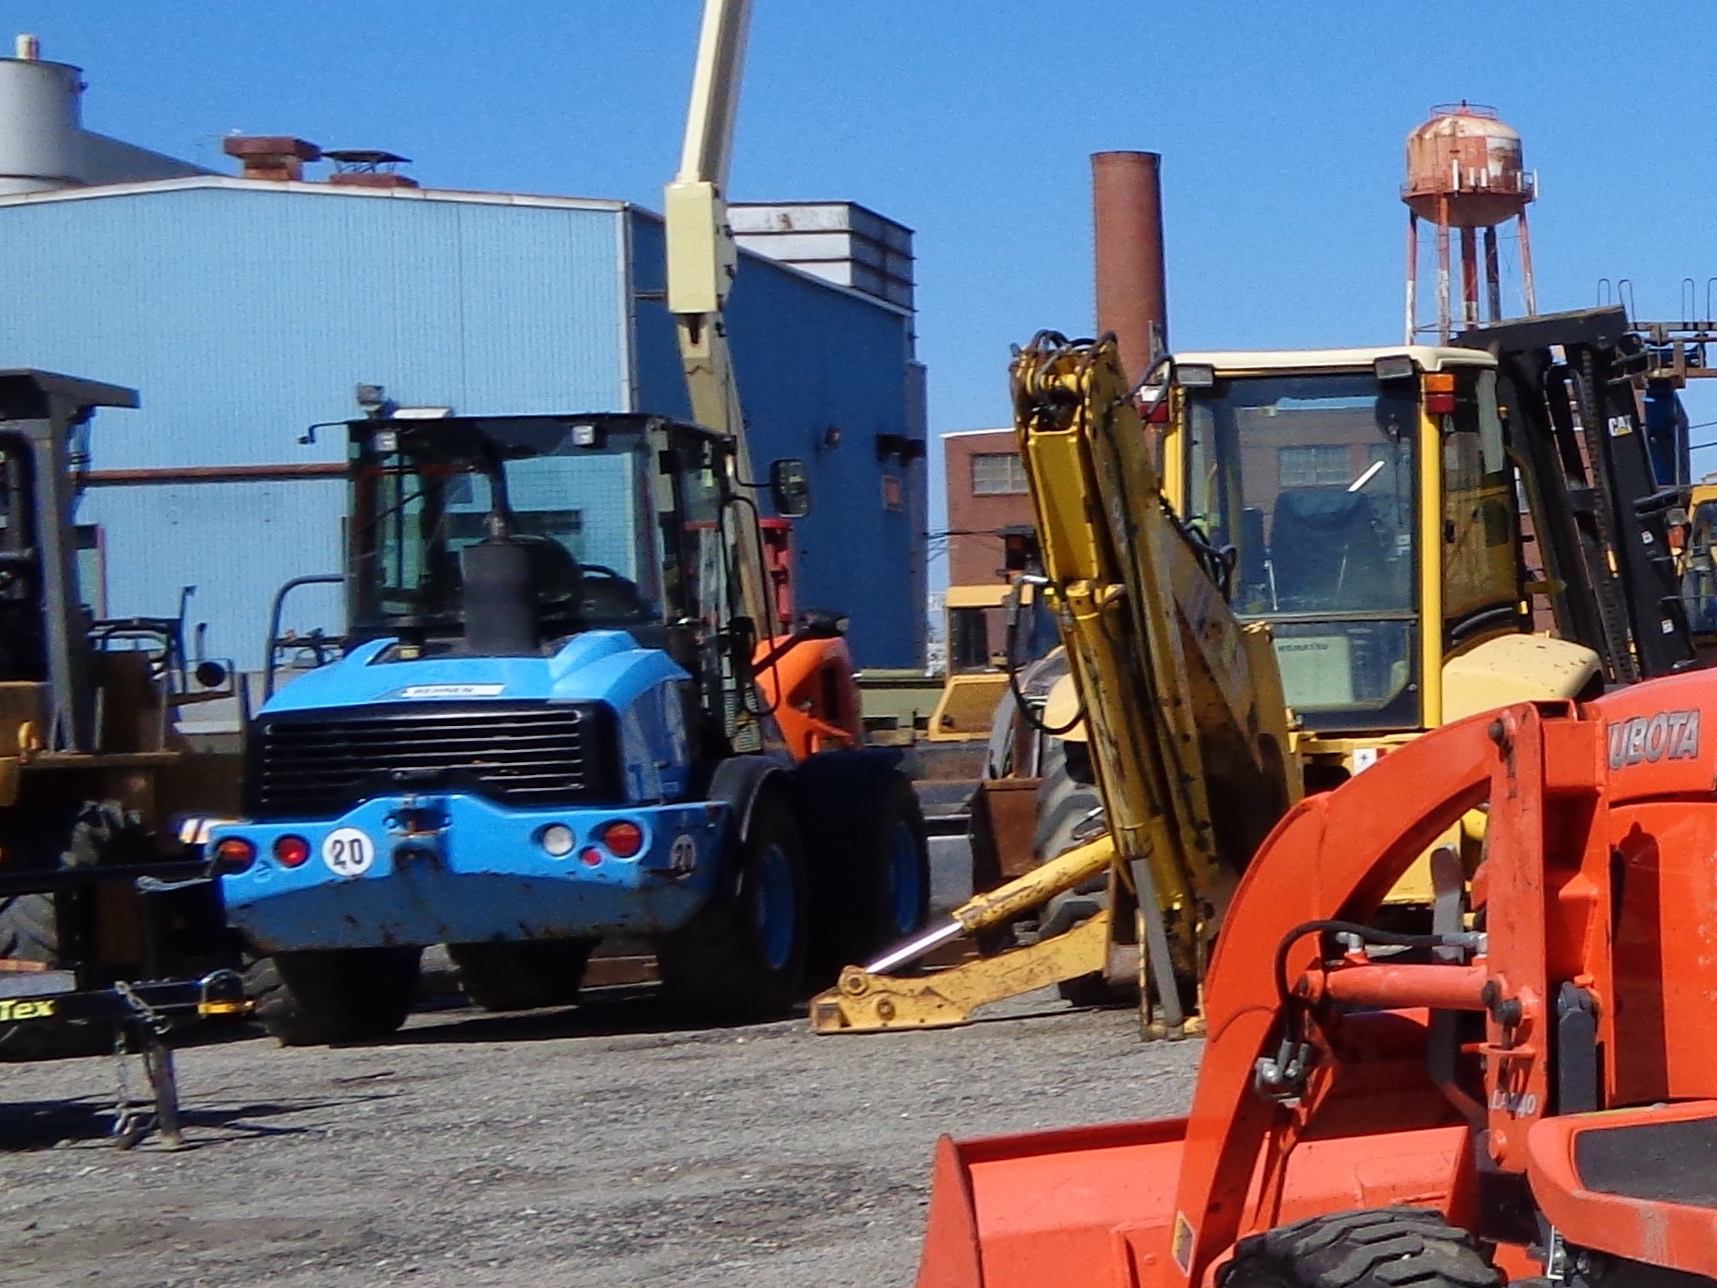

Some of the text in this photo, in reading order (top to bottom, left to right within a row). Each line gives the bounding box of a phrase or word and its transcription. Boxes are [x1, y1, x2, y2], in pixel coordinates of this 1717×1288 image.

[1609, 415, 1633, 437] CAT
[1607, 709, 1700, 771] UBOTA
[332, 838, 364, 867] 20
